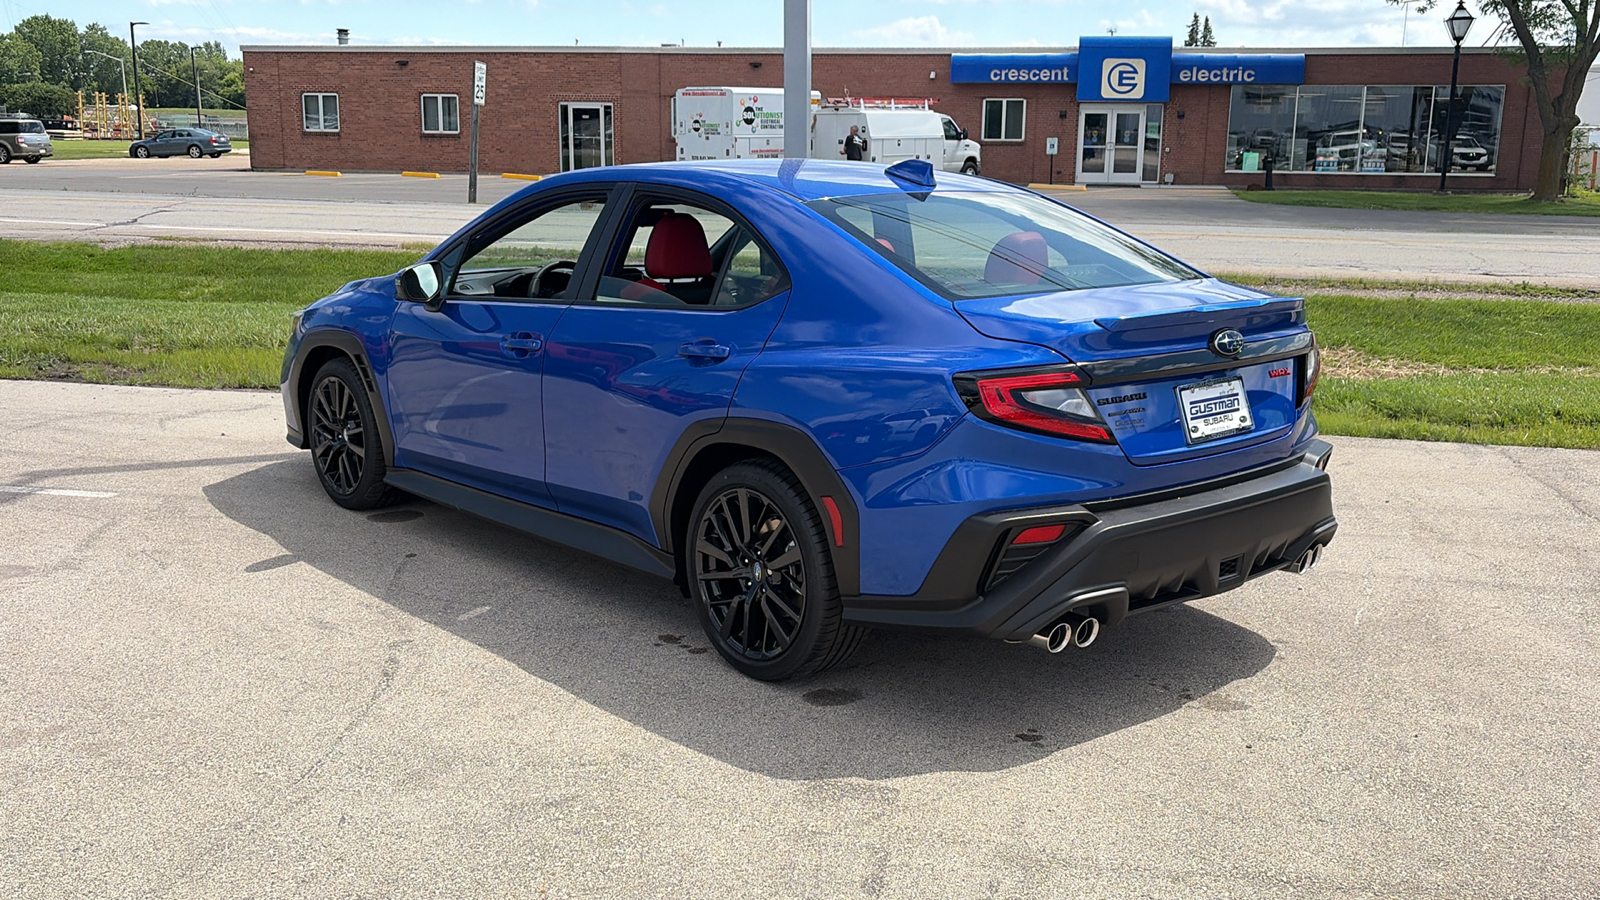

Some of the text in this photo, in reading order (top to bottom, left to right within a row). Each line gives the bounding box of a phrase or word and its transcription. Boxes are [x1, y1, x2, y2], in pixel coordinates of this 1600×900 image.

[990, 66, 1069, 81] crescent
[1179, 66, 1256, 82] electric
[475, 84, 485, 100] 25
[1268, 367, 1292, 379] WRX
[1097, 392, 1148, 406] SUBARU
[1203, 414, 1234, 427] SUBARU
